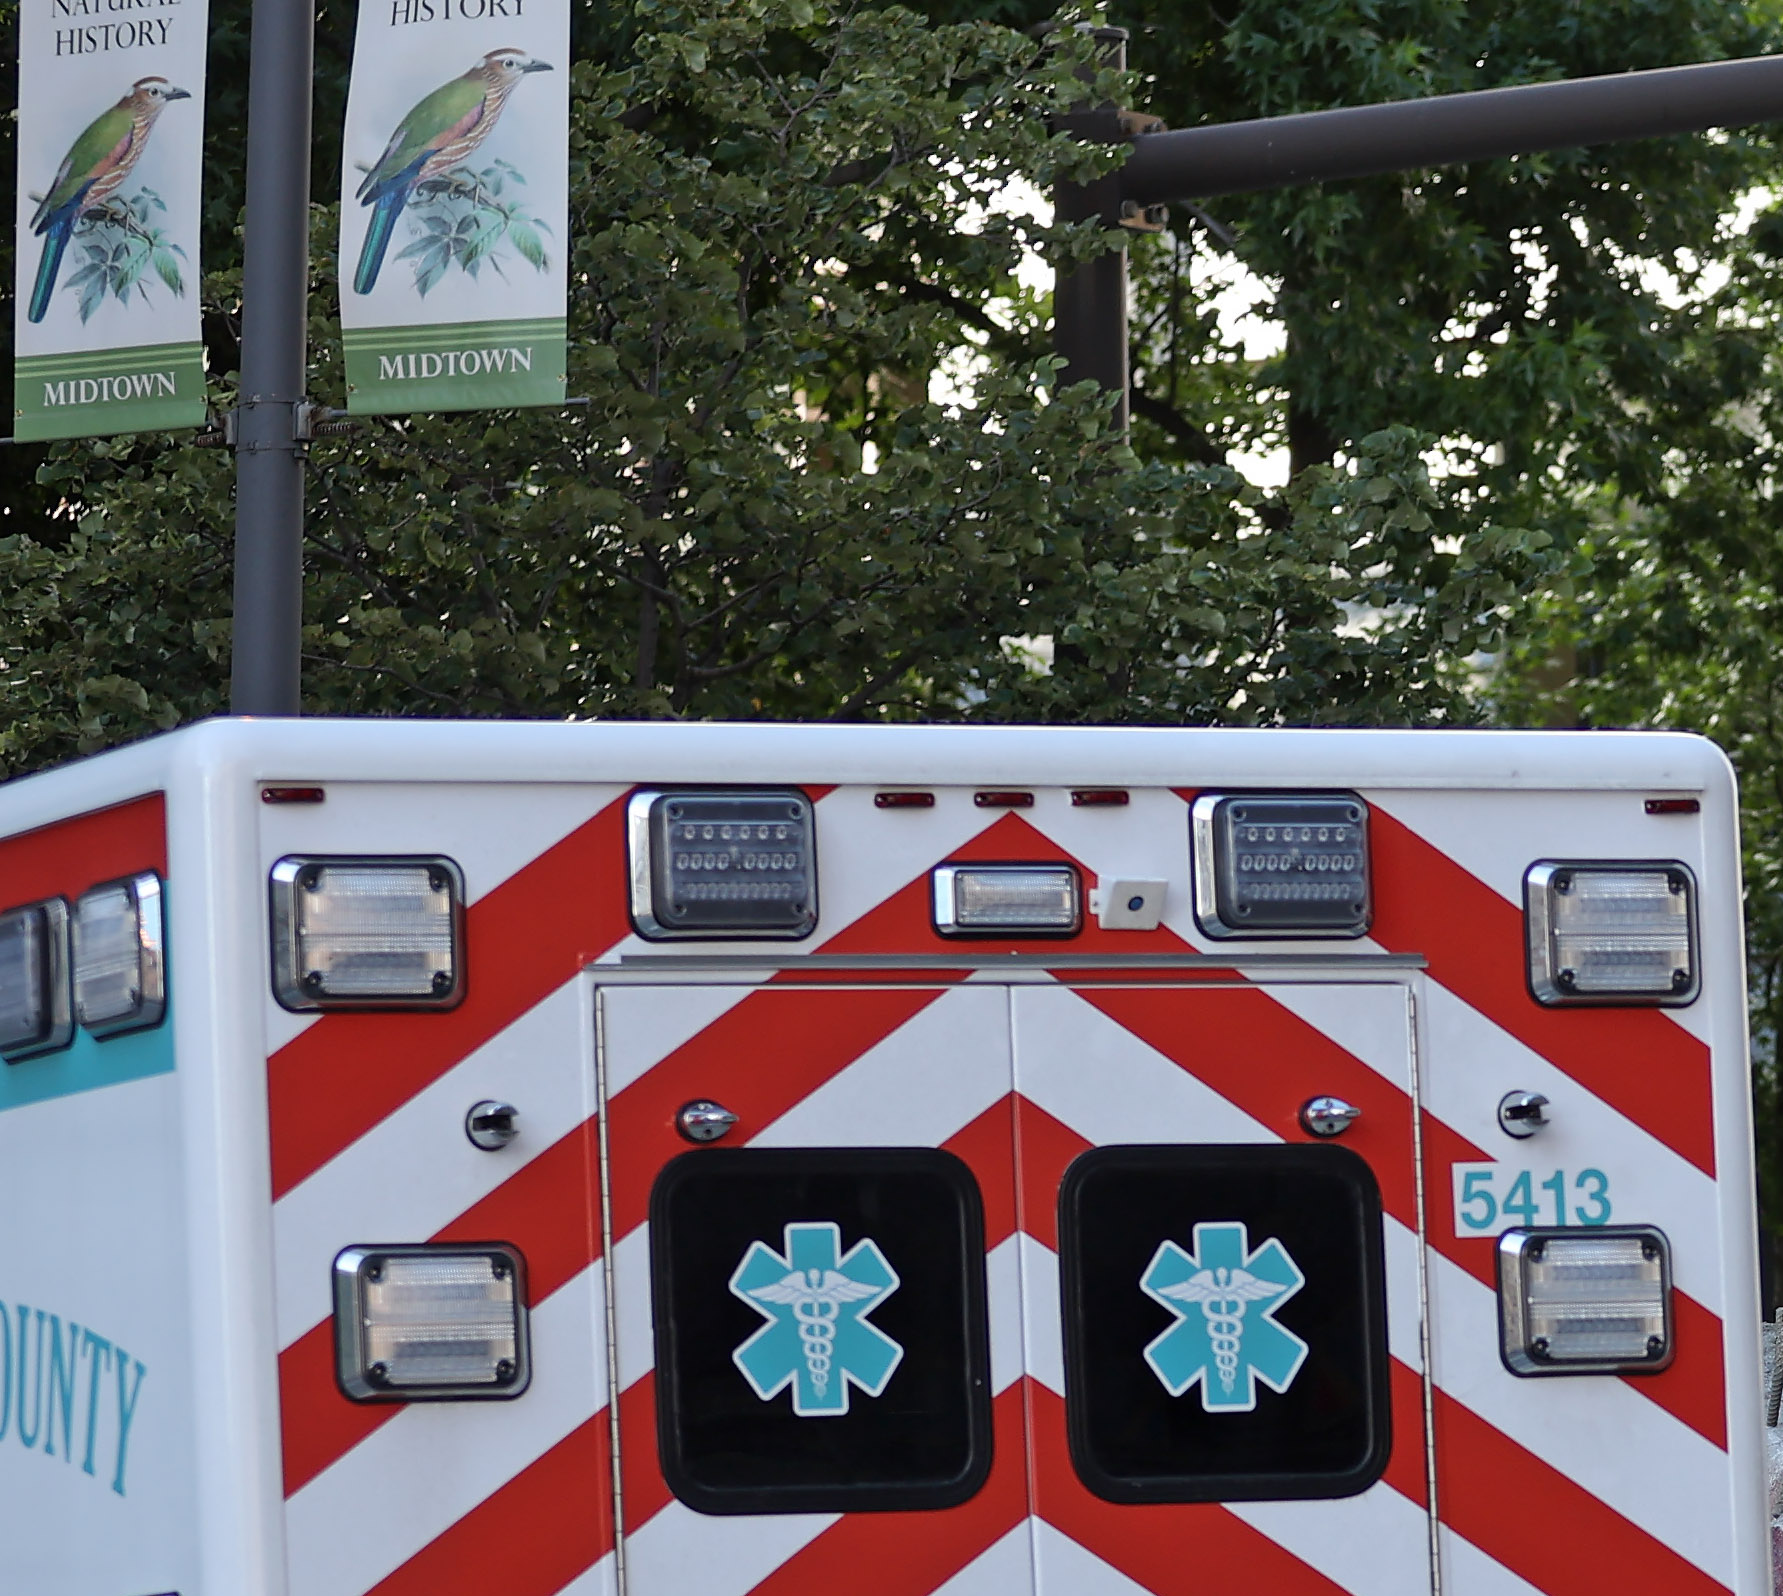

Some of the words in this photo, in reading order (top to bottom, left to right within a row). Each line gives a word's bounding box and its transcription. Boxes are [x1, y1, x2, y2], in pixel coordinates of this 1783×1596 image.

[56, 18, 173, 56] HISTORY
[378, 347, 533, 381] MIDTOWN
[43, 371, 176, 407] MIDTOWN
[1460, 1168, 1612, 1228] 5413
